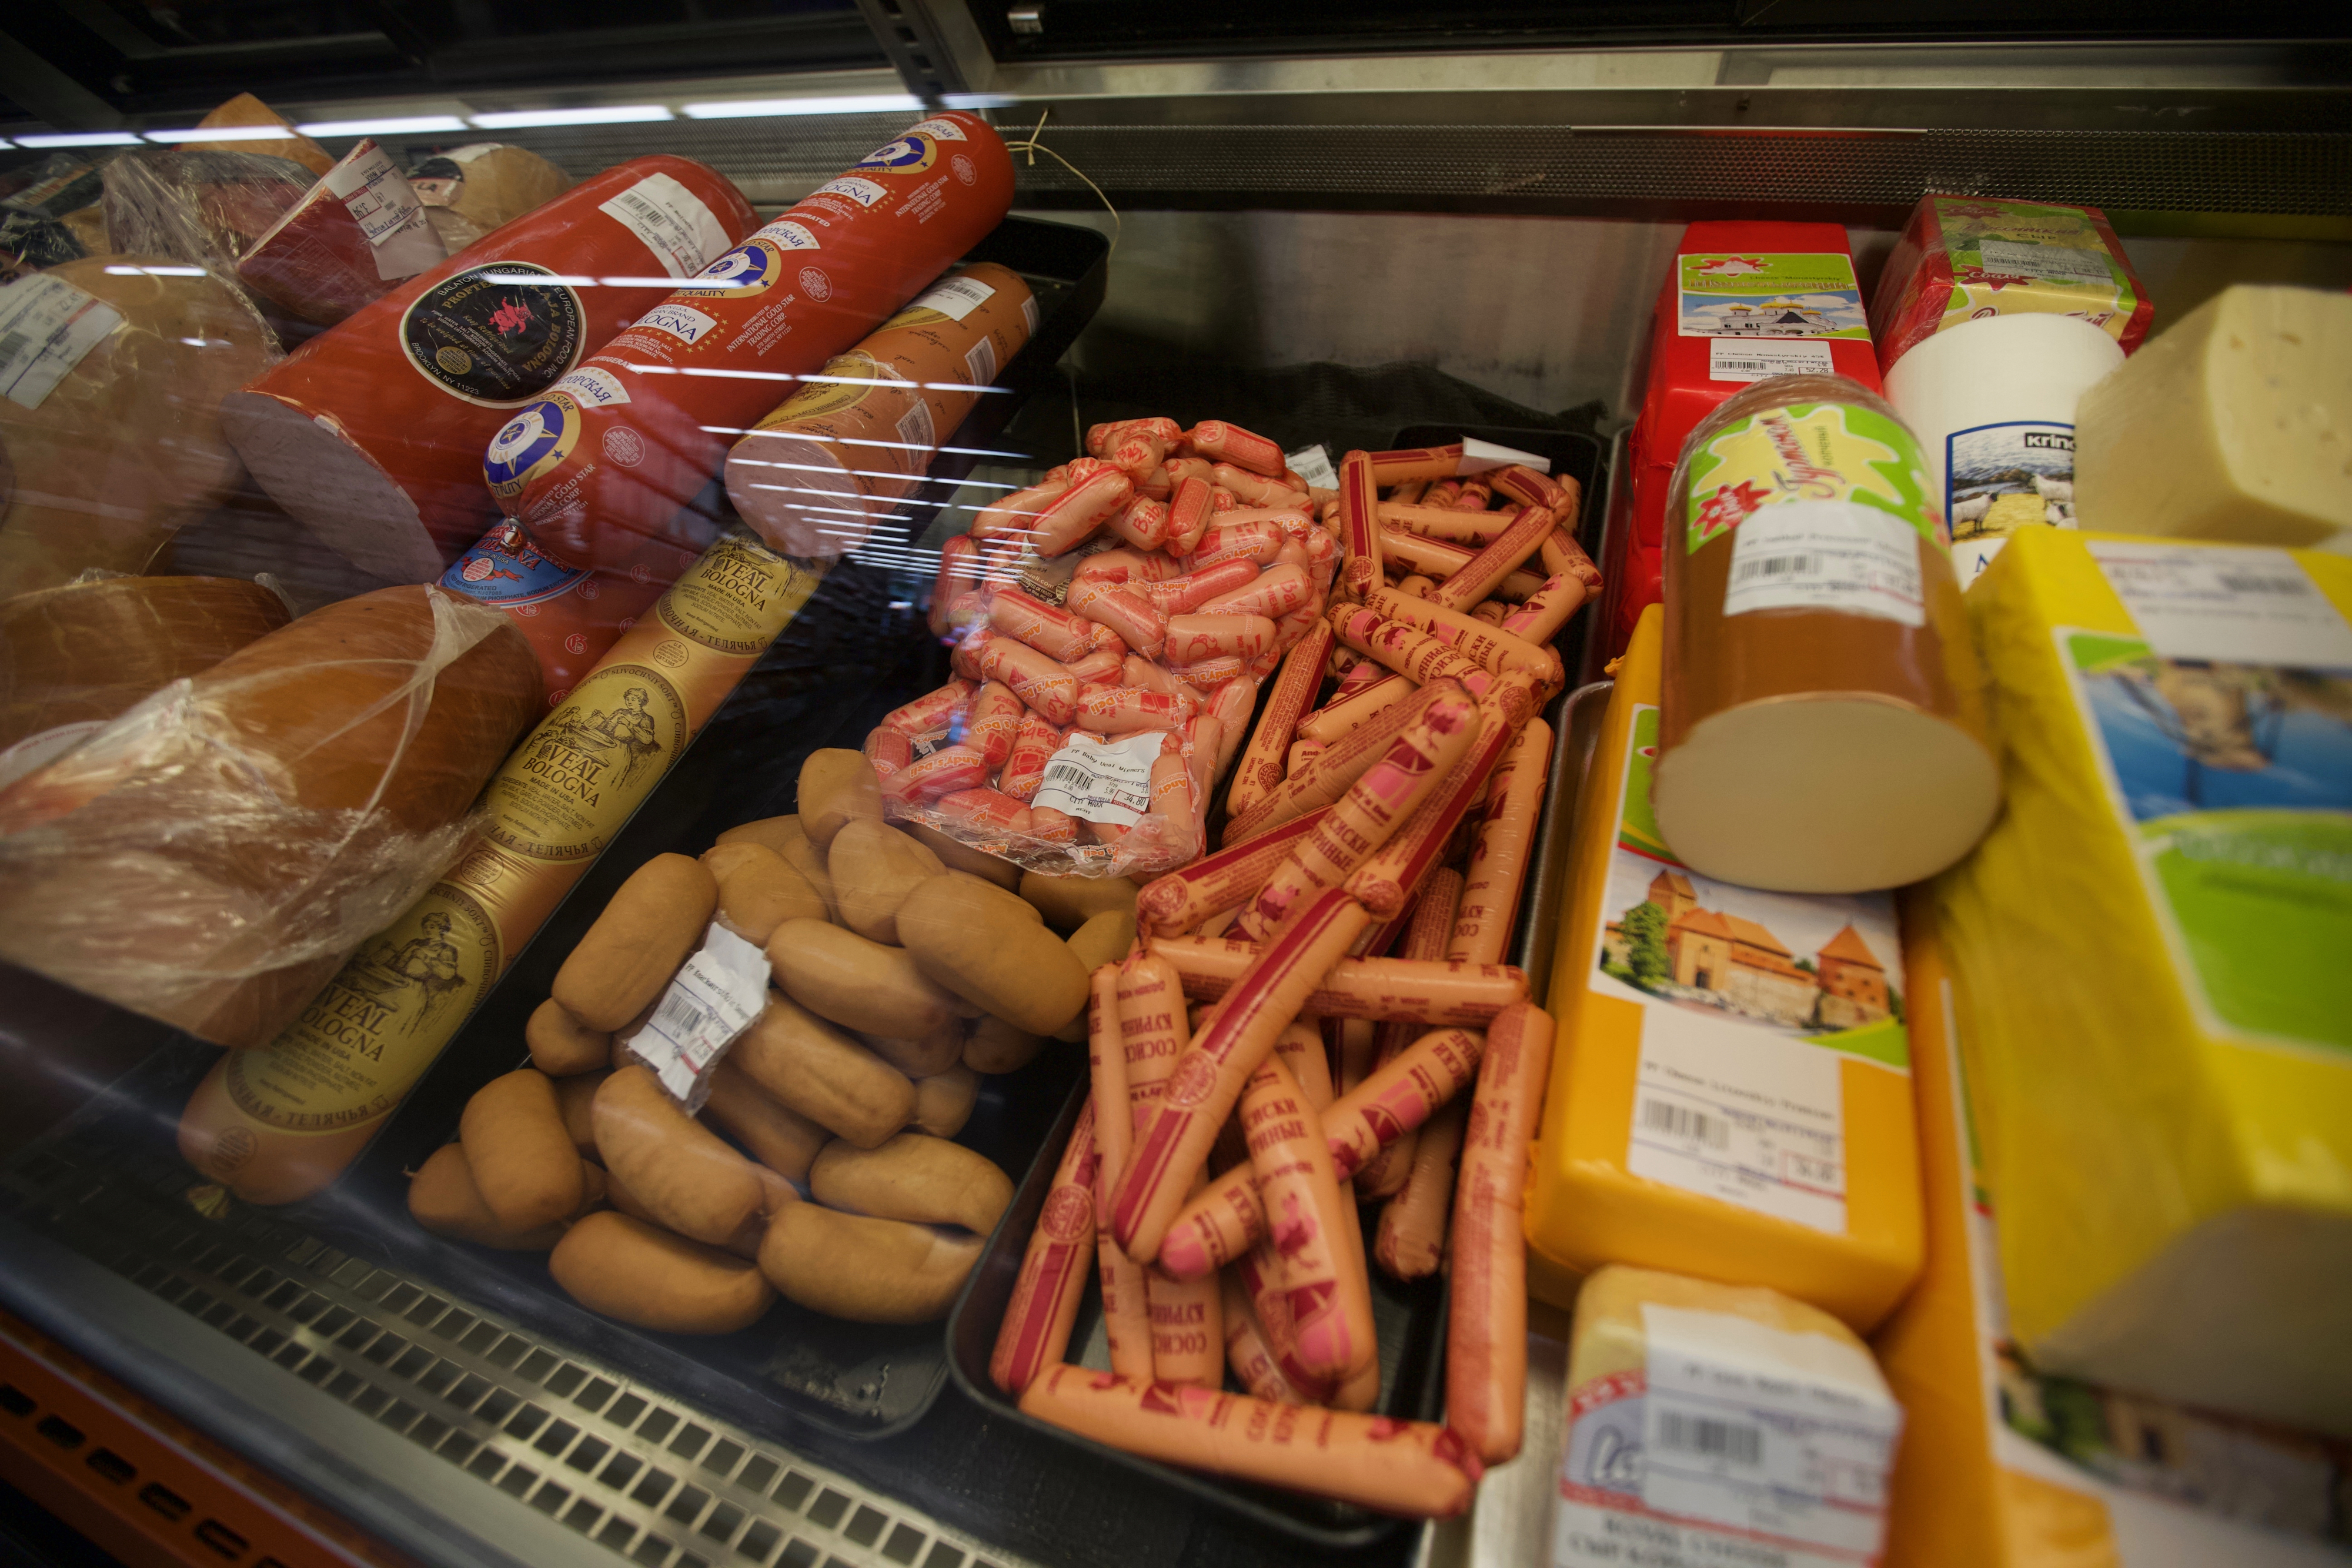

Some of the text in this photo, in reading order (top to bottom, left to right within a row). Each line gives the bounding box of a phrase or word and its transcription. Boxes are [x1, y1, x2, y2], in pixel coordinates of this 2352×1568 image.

[824, 185, 871, 203] OGNA
[895, 191, 928, 217] INTERNATIONAL
[927, 182, 939, 194] GOLD
[937, 175, 949, 186] STAR
[352, 203, 371, 219] 3.94
[911, 198, 931, 214] TRADING
[755, 241, 774, 253] STAR
[681, 254, 694, 272] 30.00
[438, 273, 478, 296] BALATON
[684, 289, 726, 297] QUALITY
[463, 315, 478, 326] Keep
[554, 287, 576, 341] EUROPEAN
[667, 310, 695, 322] BRAND
[726, 294, 796, 353] INTERNATIONAL GOLD STAR
[741, 310, 766, 329] DISTRIBUTED
[747, 312, 787, 347] TRADING CORP.
[763, 332, 776, 345] SMITH
[773, 322, 787, 336] STREET
[437, 317, 455, 329] SODIUM
[482, 349, 499, 363] SODIUM
[470, 333, 487, 347] SODIUM
[523, 323, 562, 372] BOLOGNA
[757, 326, 793, 357] BROOKLYN, NY 11231
[436, 326, 462, 345] weighed
[486, 366, 510, 390] purchase
[554, 340, 572, 365] FOOD,
[412, 342, 442, 377] BROOKLYN,
[443, 375, 455, 384] NY
[457, 383, 479, 395] 11223
[542, 366, 558, 379] INC.
[554, 395, 574, 412] STAR
[554, 463, 596, 500] GOLD STAR
[559, 488, 583, 510] CORP.
[496, 556, 510, 565] USA
[455, 579, 497, 591] REFRIGERATED
[721, 558, 767, 593] VEAL
[526, 587, 550, 596] SODIUM
[699, 594, 715, 603] GARLIC
[700, 568, 766, 612] BOLOGNA
[707, 584, 727, 594] MADE
[732, 596, 745, 607] USA
[691, 602, 709, 613] SODIUM
[1077, 591, 1097, 612] Deli
[700, 599, 742, 630] SODIUM PHOSPHATE,
[744, 613, 756, 623] NON
[754, 621, 762, 630] FAT
[707, 635, 756, 651] ТЕЛЯЧЬЯ
[612, 668, 674, 702] SLIVOCHNIY SORT
[1035, 677, 1074, 693] Andy's
[1174, 666, 1240, 685] Andy's Deli
[1090, 697, 1115, 716] Deli
[975, 721, 1003, 734] Deli
[548, 744, 602, 786] VEAL
[910, 755, 981, 778] Andy's Deli
[1082, 751, 1097, 763] Baby
[1245, 757, 1257, 774] WEIGHT
[522, 757, 600, 808] BOLOGNA
[530, 777, 550, 790] MADE
[559, 793, 574, 805] USA
[1070, 796, 1104, 808] CITY MAXX
[1124, 793, 1146, 807] 34.80
[527, 842, 588, 857] ТЕЛЯЧЬЯ
[323, 985, 389, 1036] VEAL
[301, 1007, 385, 1062] OLOGNA
